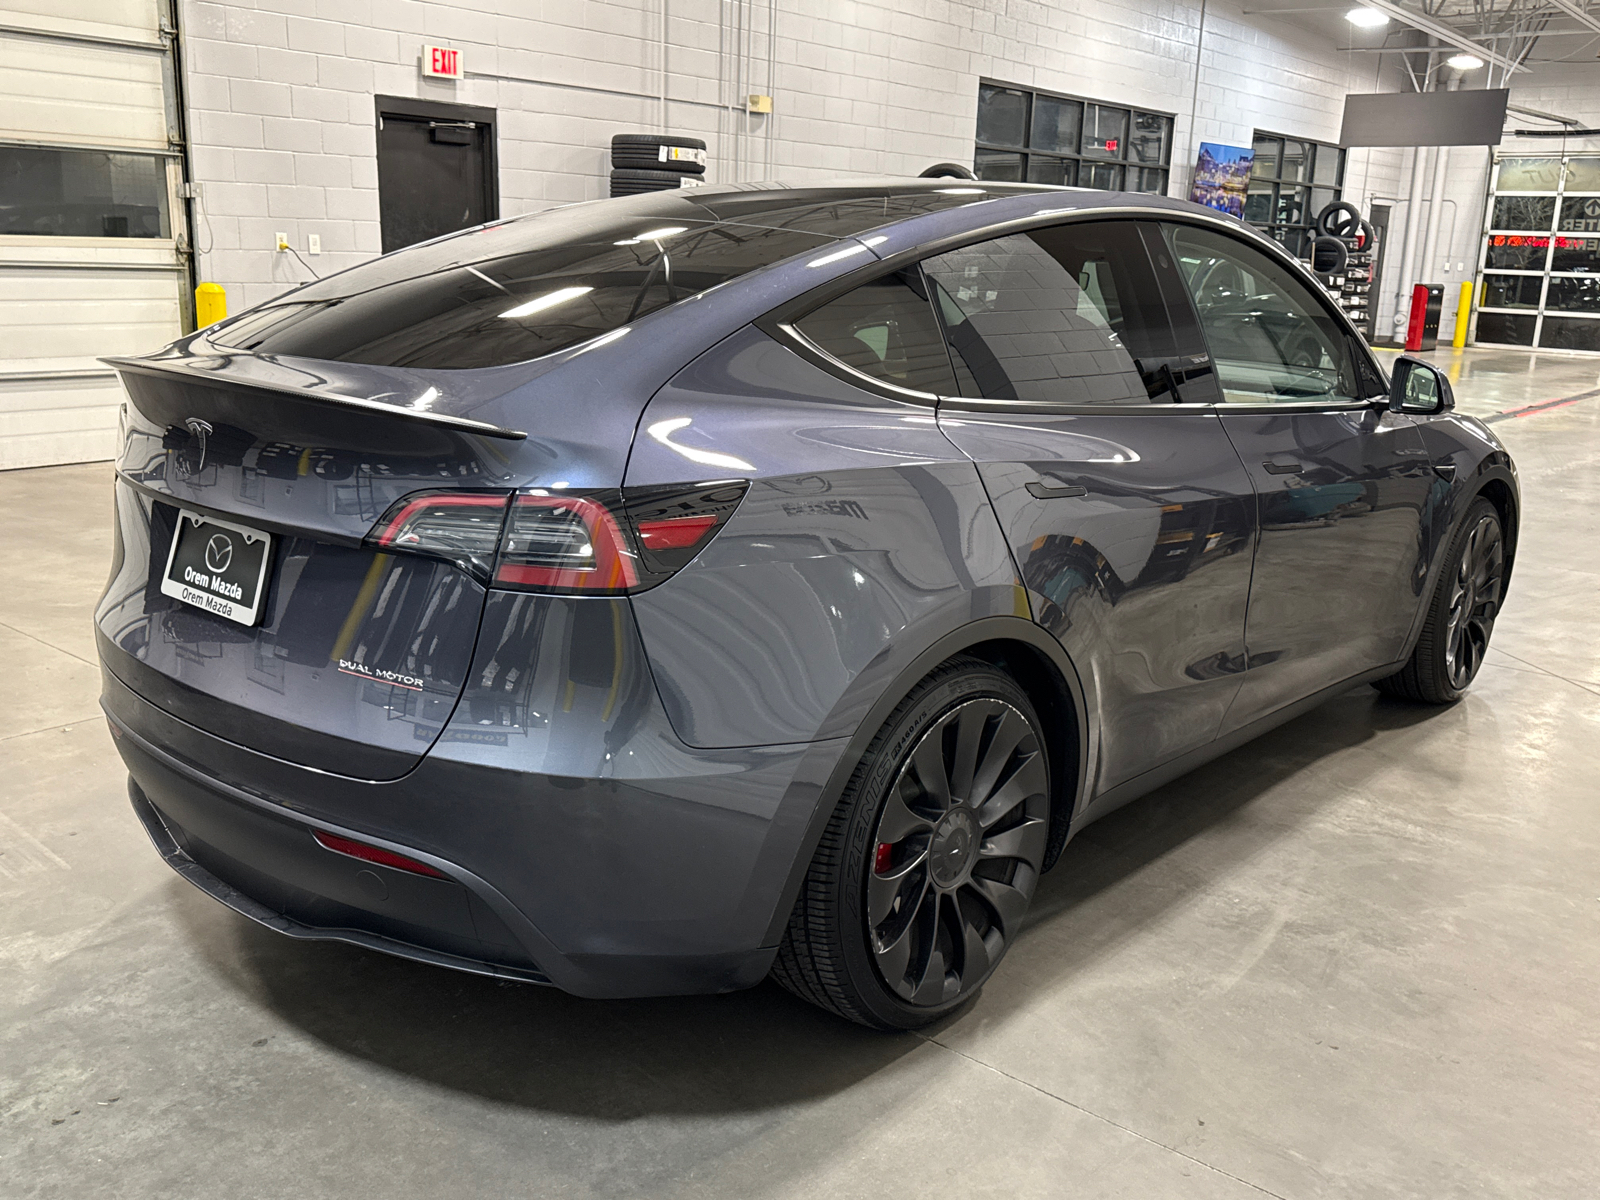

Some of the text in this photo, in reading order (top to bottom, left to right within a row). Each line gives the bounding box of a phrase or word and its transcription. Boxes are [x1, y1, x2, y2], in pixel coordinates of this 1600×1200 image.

[432, 47, 458, 76] EXIT
[184, 565, 243, 600] Orem Mazda
[181, 587, 233, 616] Orem Mazda
[339, 658, 424, 687] DUAL MOTOR
[845, 751, 894, 915] AZENIS
